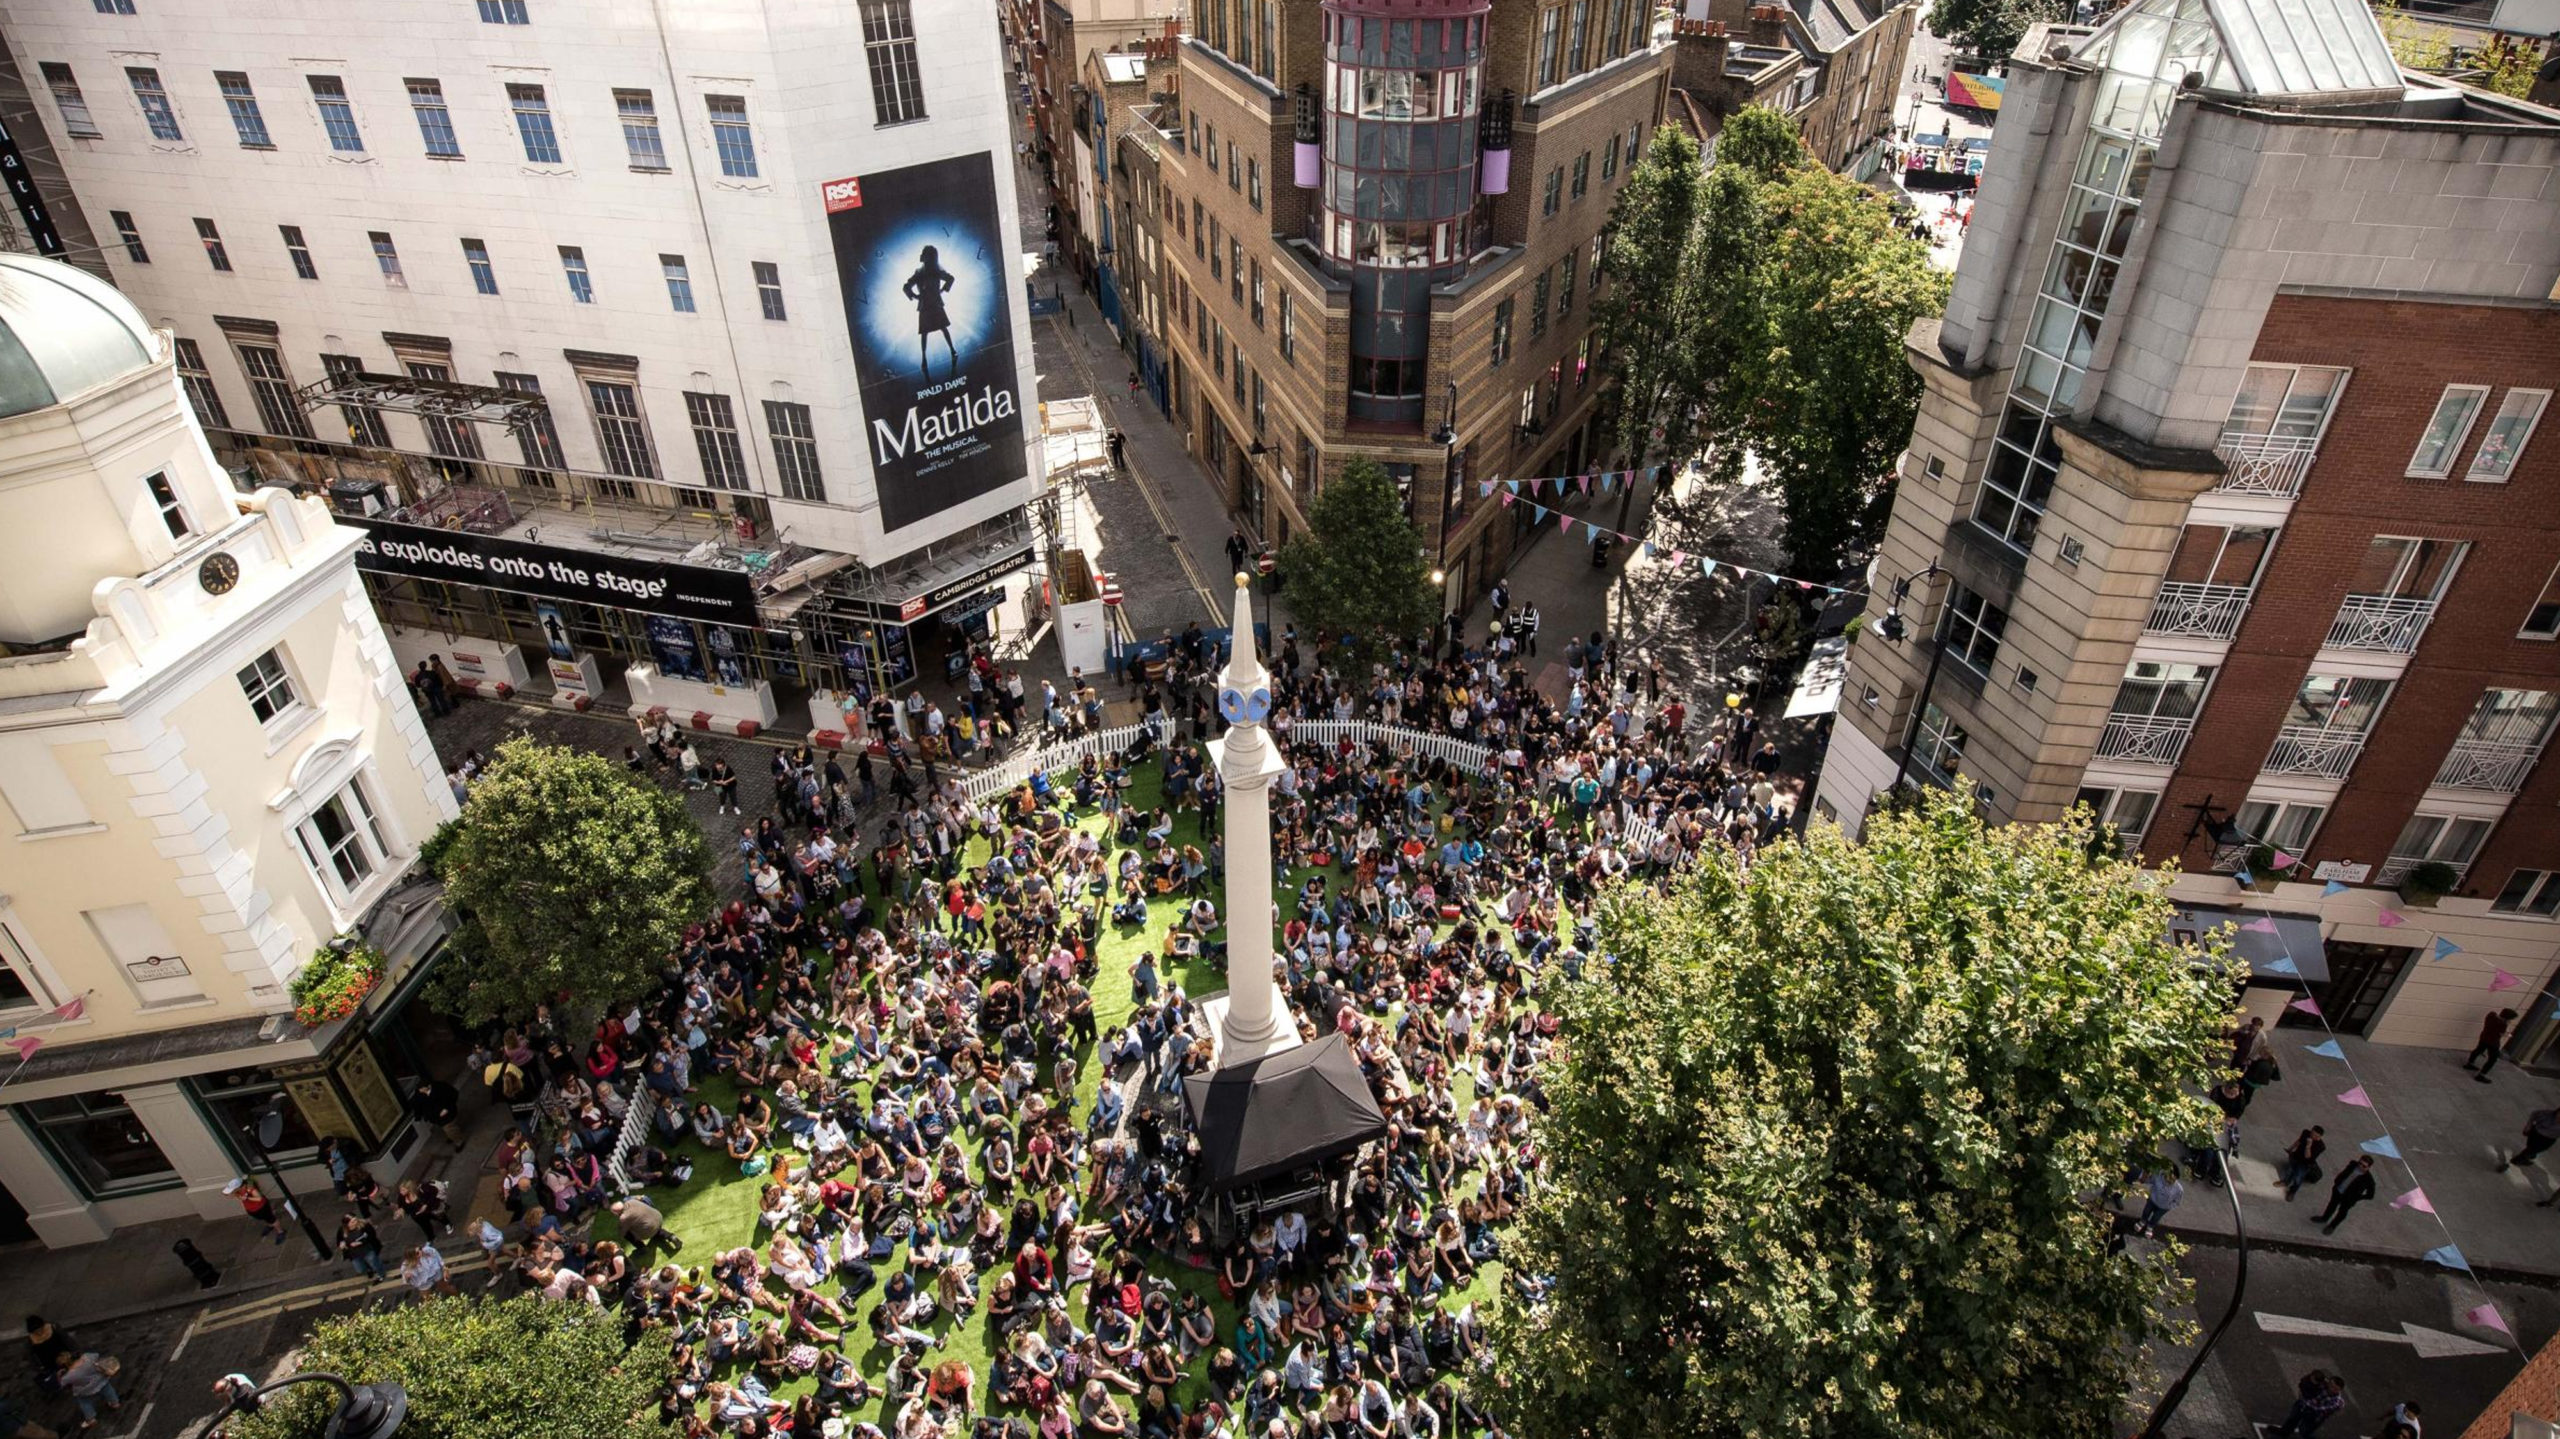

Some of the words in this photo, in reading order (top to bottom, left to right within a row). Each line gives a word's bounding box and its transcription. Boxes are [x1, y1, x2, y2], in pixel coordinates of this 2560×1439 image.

[825, 180, 858, 201] RSC
[872, 384, 1016, 466] Matilda
[924, 447, 941, 460] THE
[942, 434, 978, 454] MUSICAL
[380, 541, 485, 571] explodes
[489, 556, 545, 579] onto
[548, 562, 590, 586] the
[934, 572, 988, 601] CAMBRIDGE
[989, 554, 1026, 577] THEATRE
[676, 594, 733, 607] INDEPENDENT
[902, 598, 924, 615] RSC
